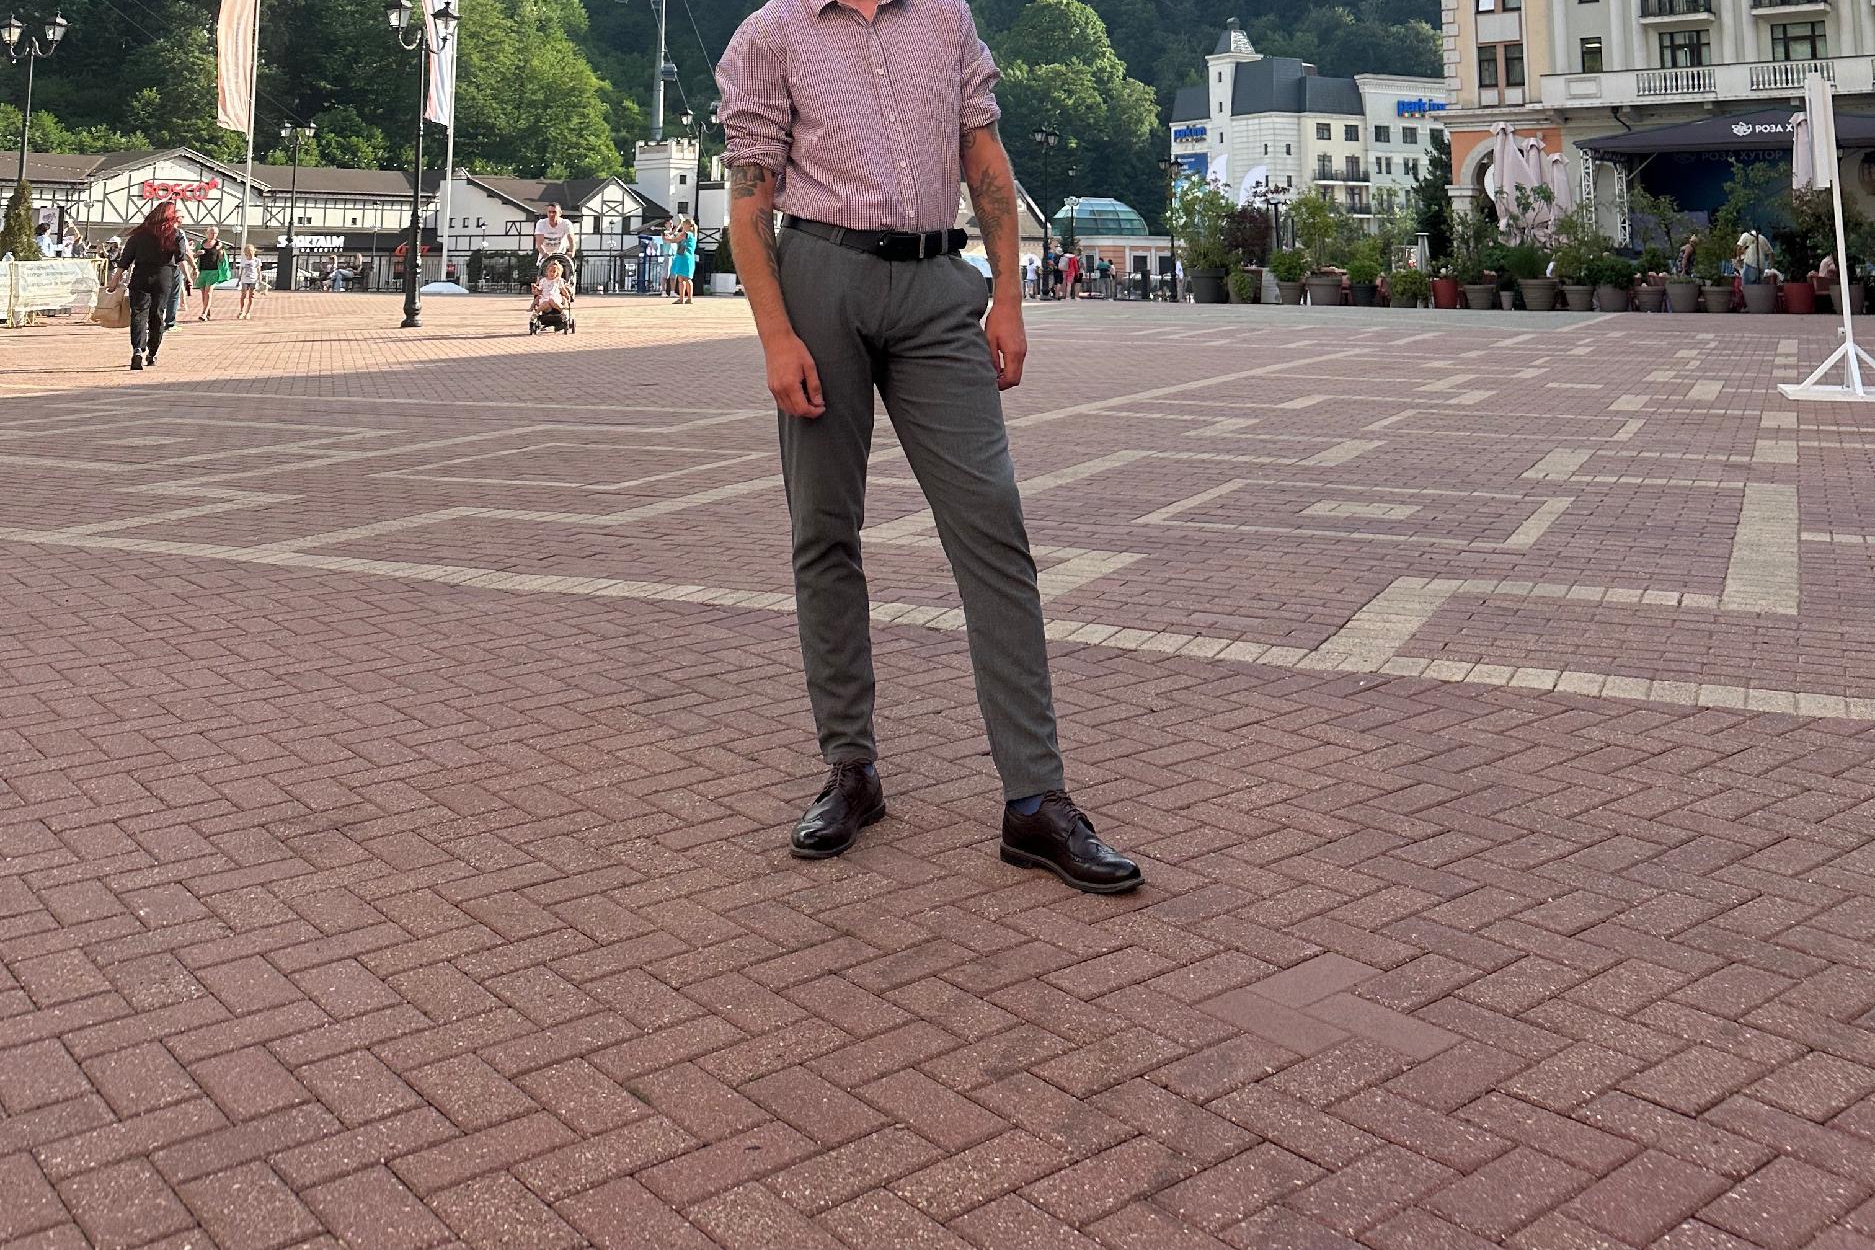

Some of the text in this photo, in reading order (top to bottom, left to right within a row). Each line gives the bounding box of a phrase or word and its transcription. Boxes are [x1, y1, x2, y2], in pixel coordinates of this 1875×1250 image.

[1397, 98, 1427, 117] park
[1755, 124, 1784, 133] РОЗА
[1702, 150, 1783, 161] РОЗА ХУТОР
